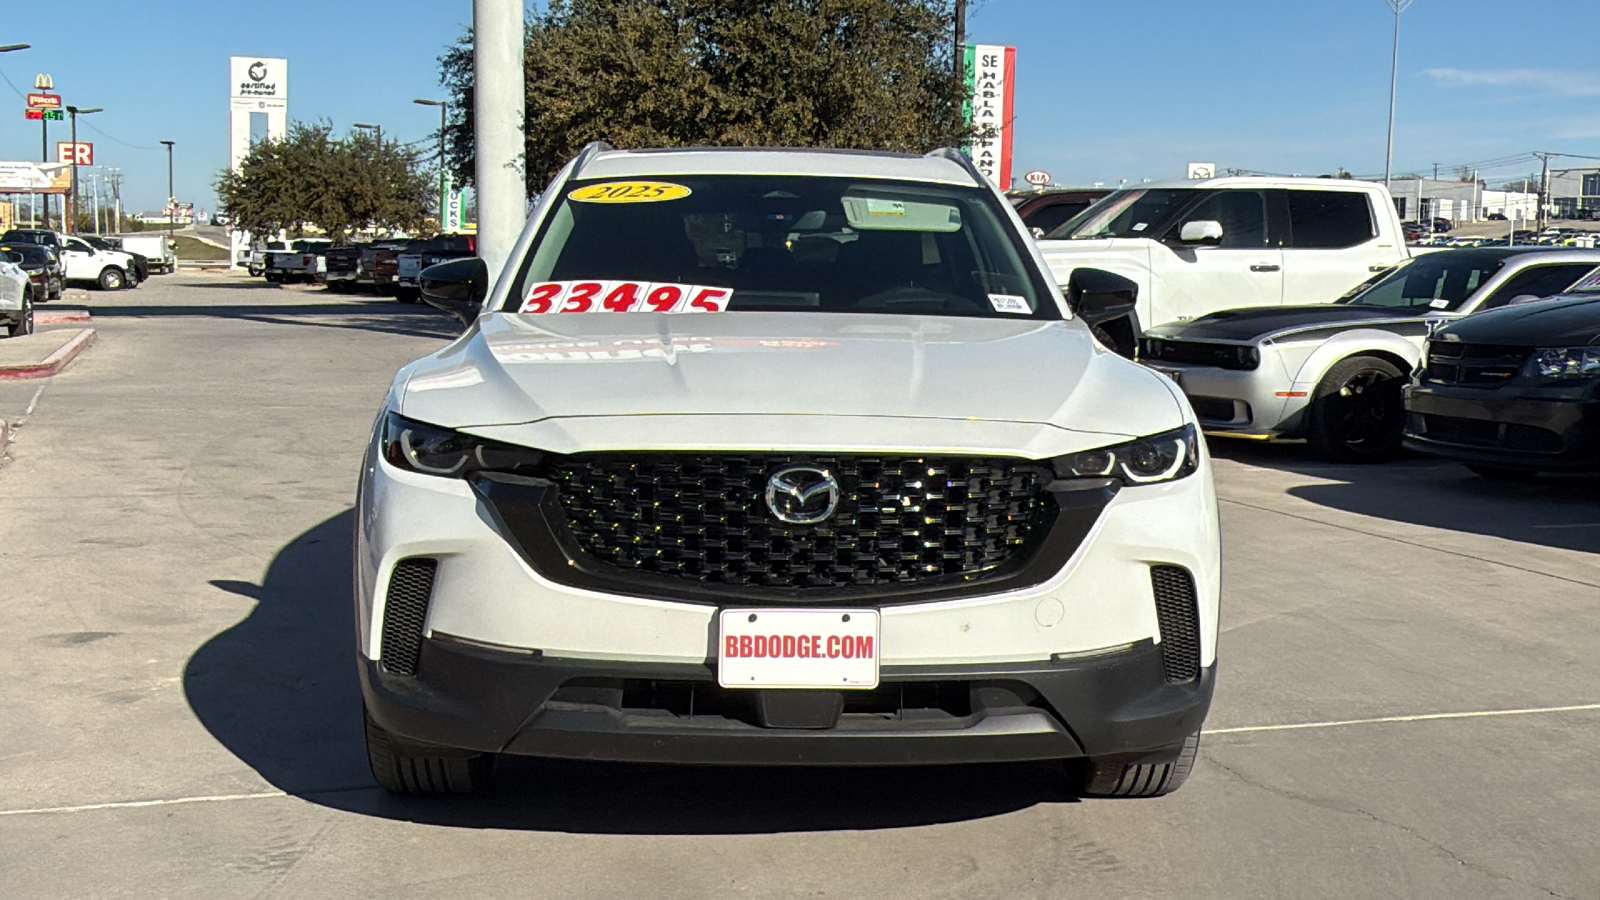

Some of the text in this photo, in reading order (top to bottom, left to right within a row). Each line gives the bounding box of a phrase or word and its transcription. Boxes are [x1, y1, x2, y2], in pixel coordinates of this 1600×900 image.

[982, 55, 998, 68] SE
[240, 82, 276, 90] certified
[981, 72, 996, 118] HABLA
[58, 143, 92, 165] ER
[1030, 174, 1046, 182] KIA
[588, 184, 674, 200] 2025
[521, 282, 728, 314] 33495
[725, 634, 874, 659] BBDODGE.COM
